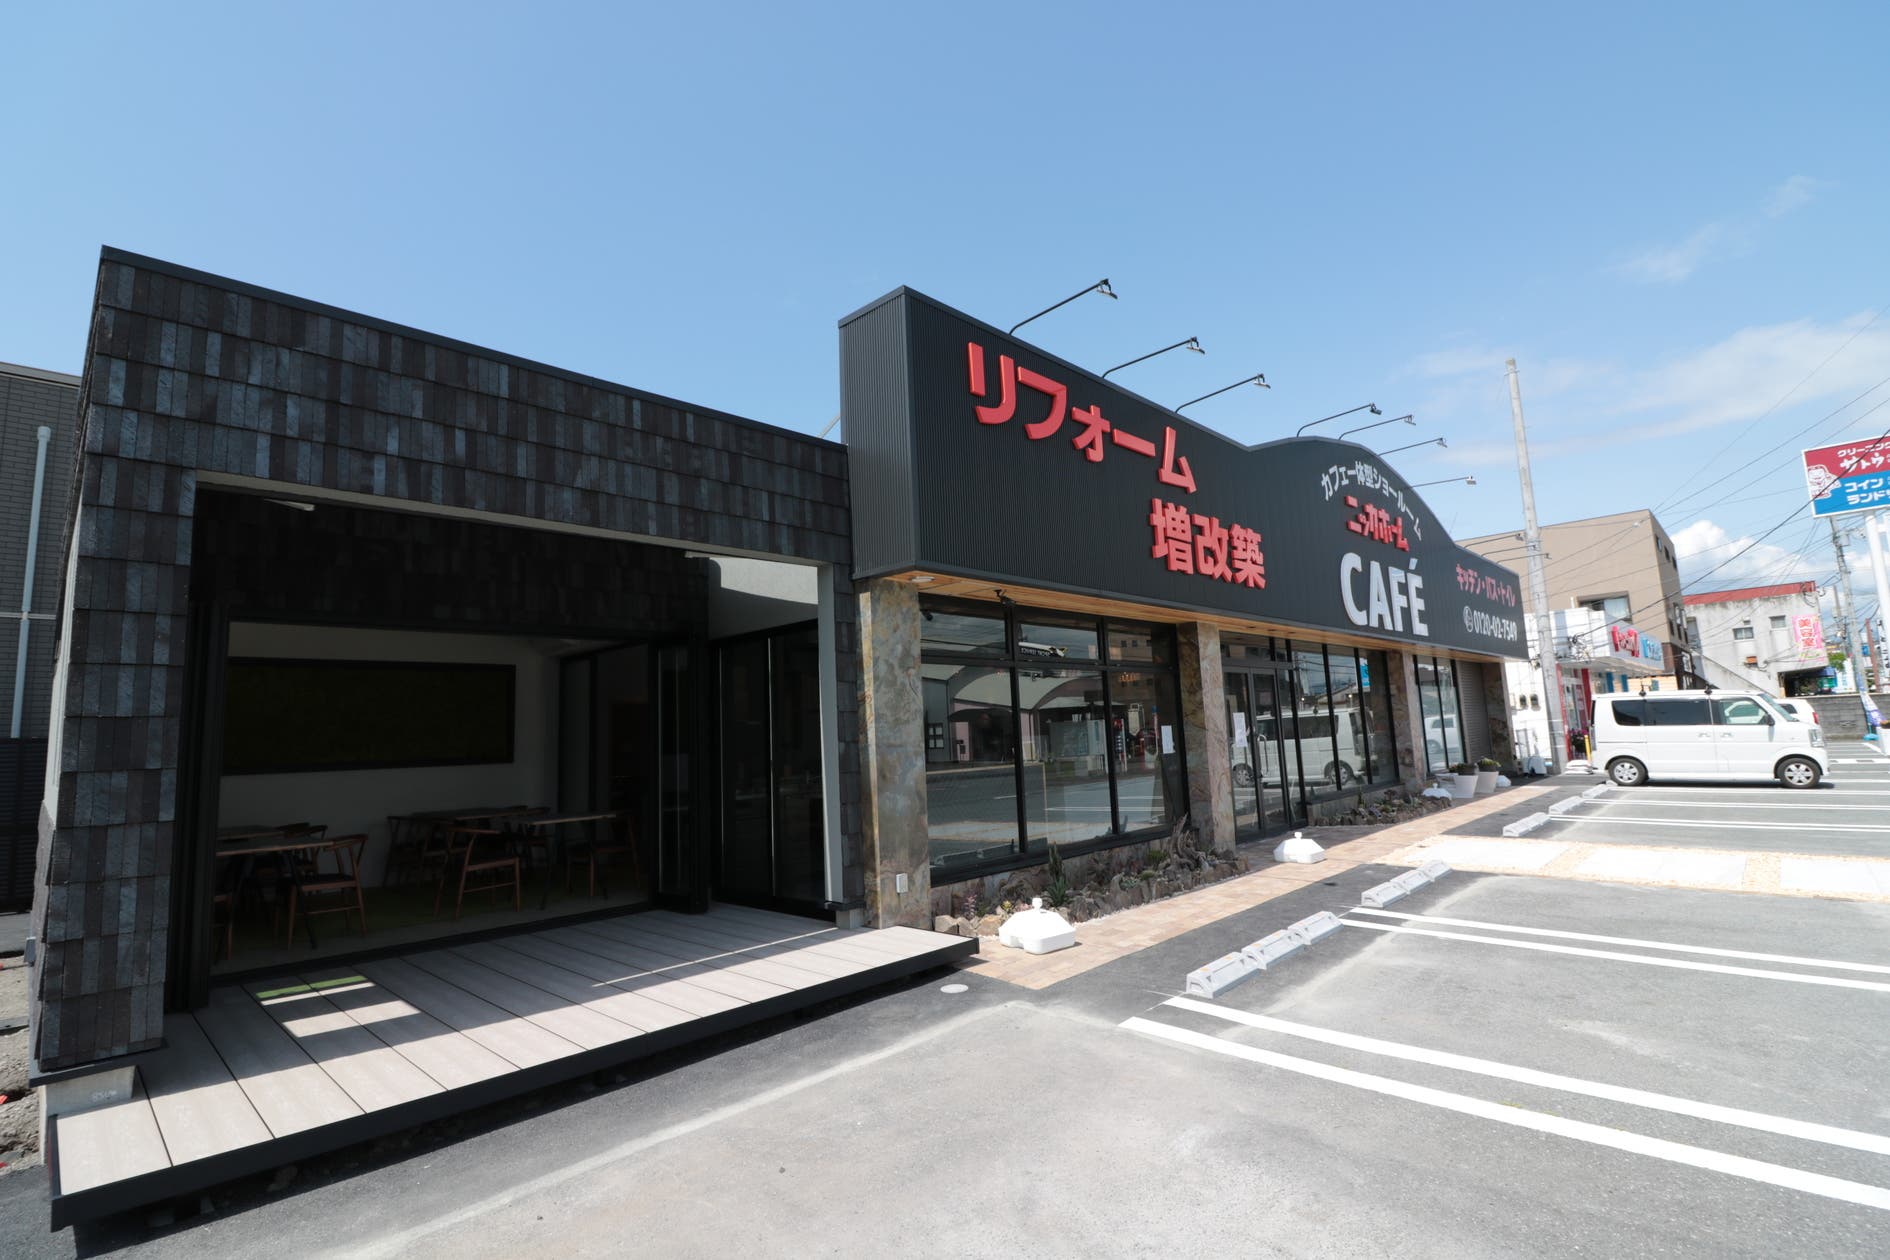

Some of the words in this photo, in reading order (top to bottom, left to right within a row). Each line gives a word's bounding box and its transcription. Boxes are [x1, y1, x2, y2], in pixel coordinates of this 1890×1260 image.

[968, 342, 1197, 494] リフォーム
[1839, 452, 1885, 473] サトウ
[1844, 478, 1884, 493] コイン
[1150, 498, 1266, 589] 増改築
[1340, 552, 1429, 636] CAFÉ
